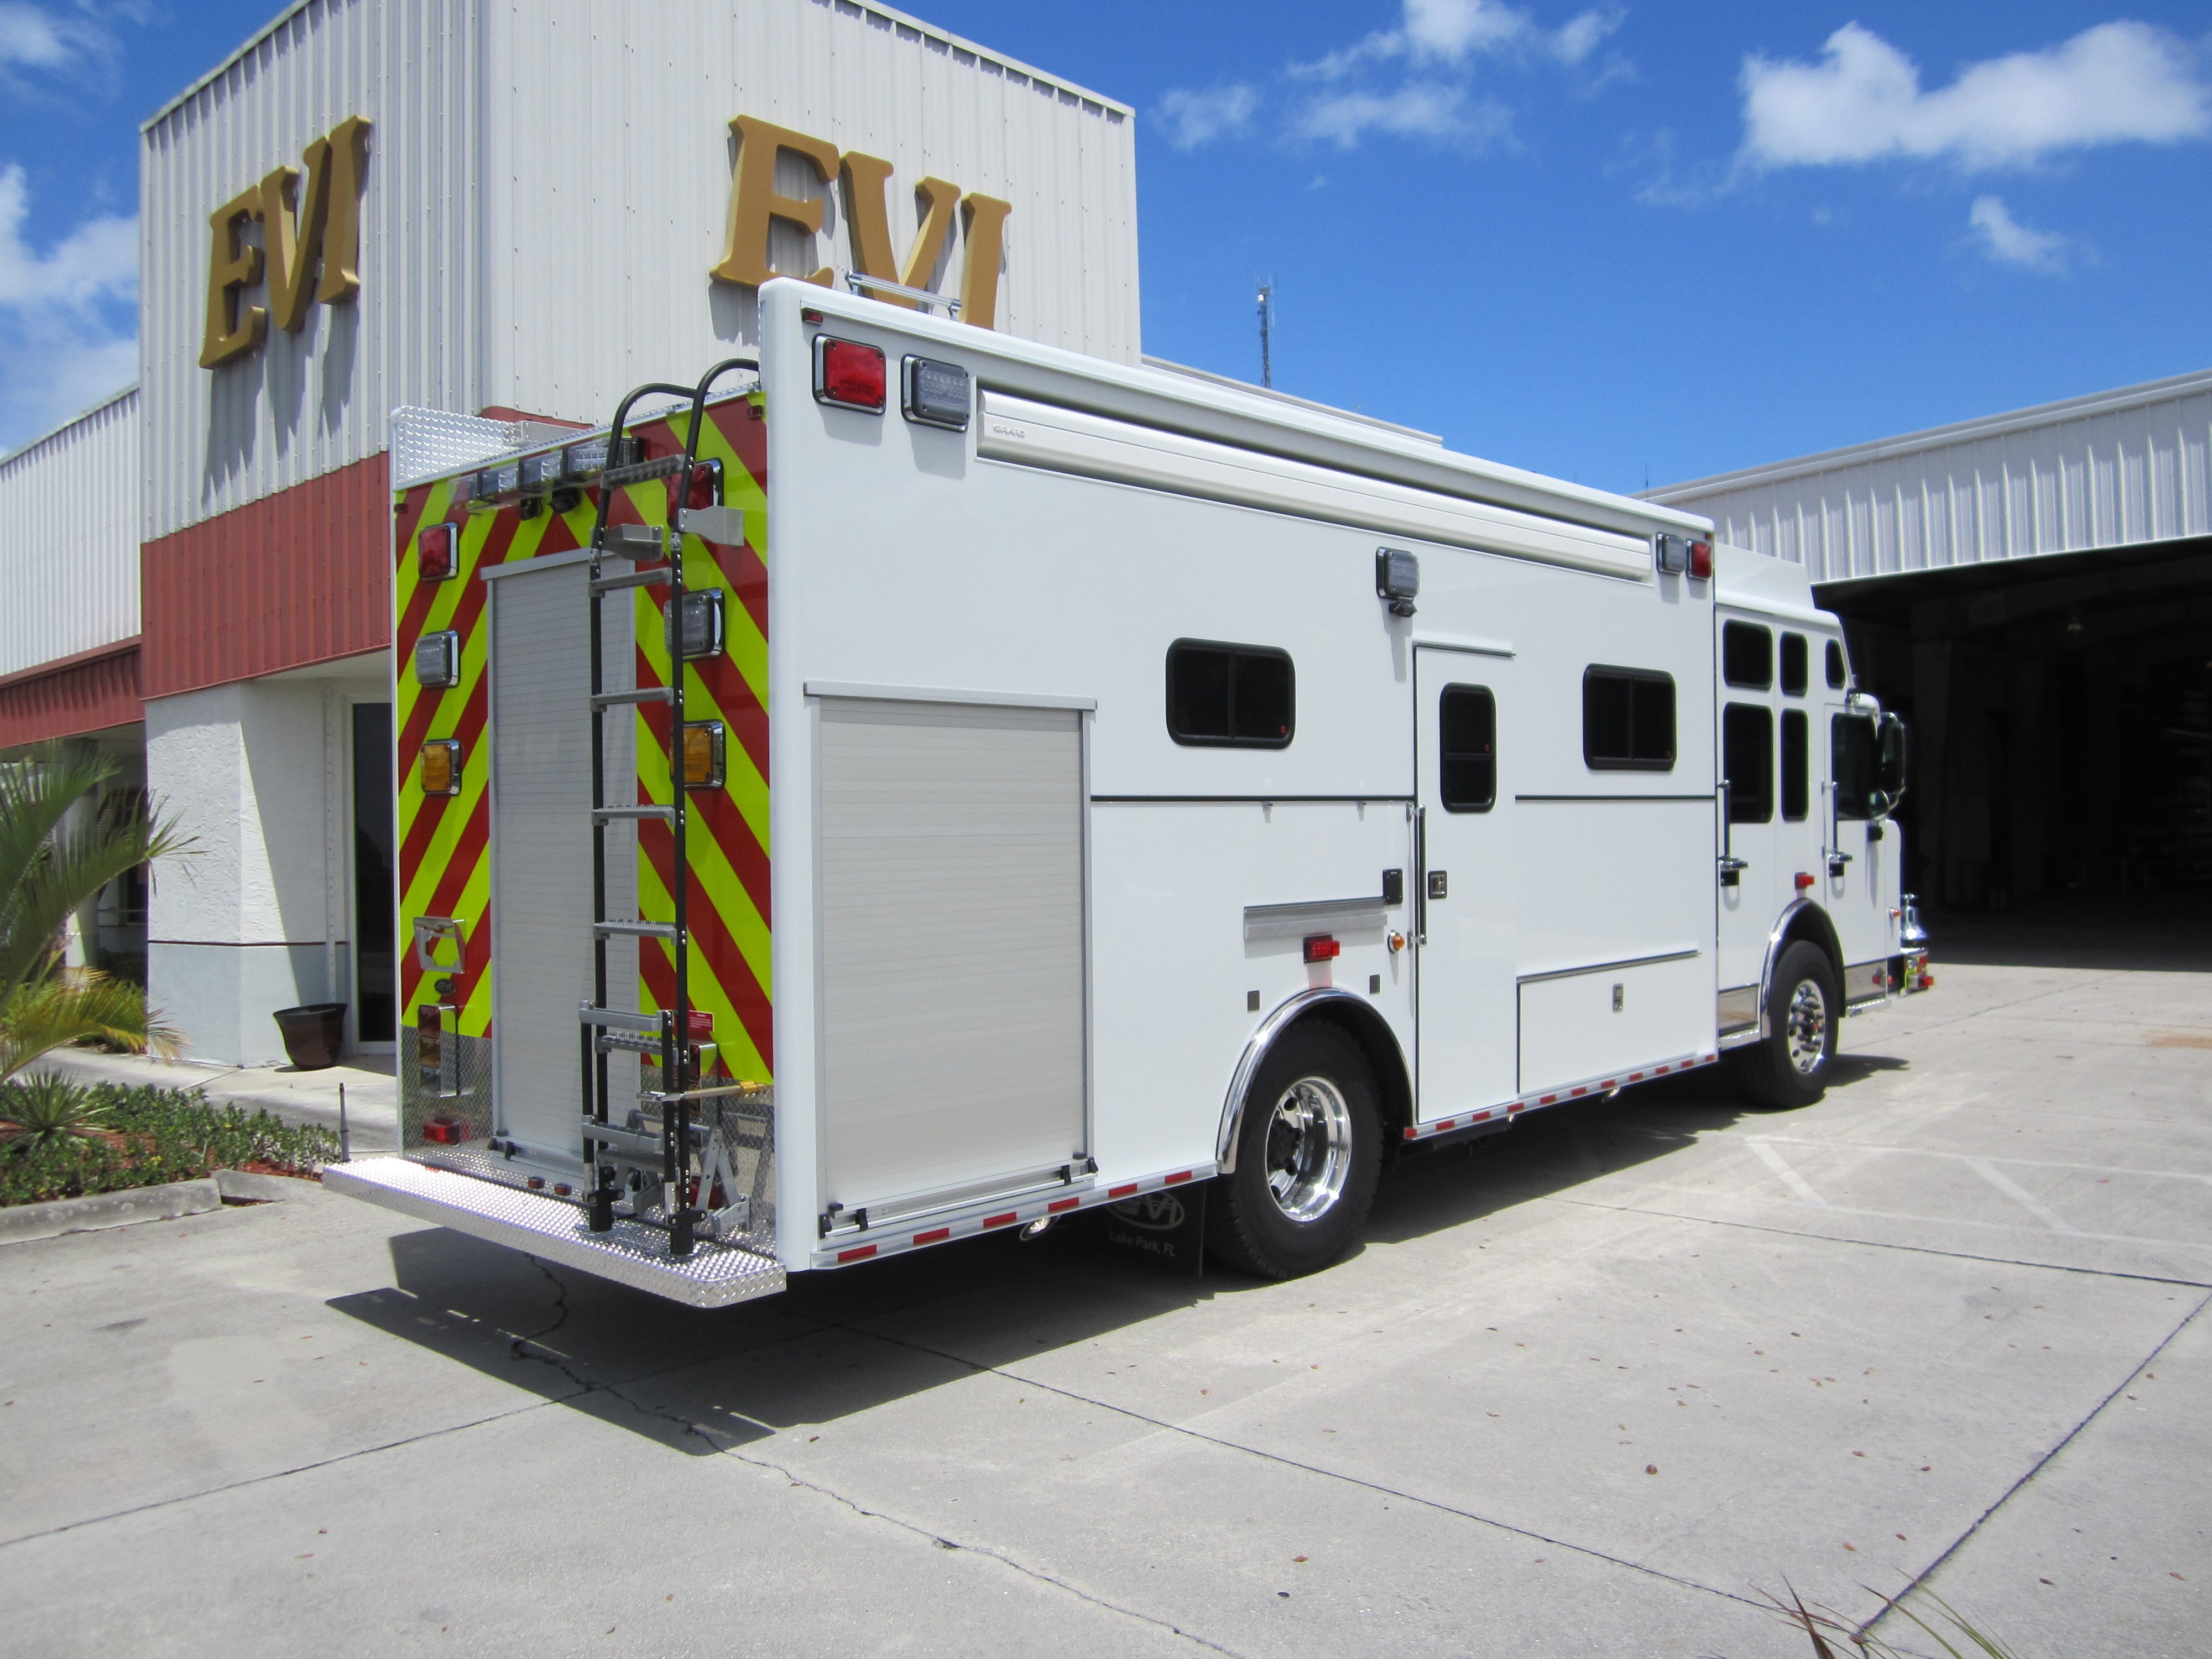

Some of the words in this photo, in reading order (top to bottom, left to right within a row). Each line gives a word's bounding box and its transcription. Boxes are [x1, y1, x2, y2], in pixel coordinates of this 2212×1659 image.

[199, 115, 372, 369] EVI
[709, 114, 1012, 331] EVI
[1109, 1230, 1133, 1246] Lake
[1135, 1236, 1160, 1254] Park,
[1164, 1243, 1176, 1257] FL
